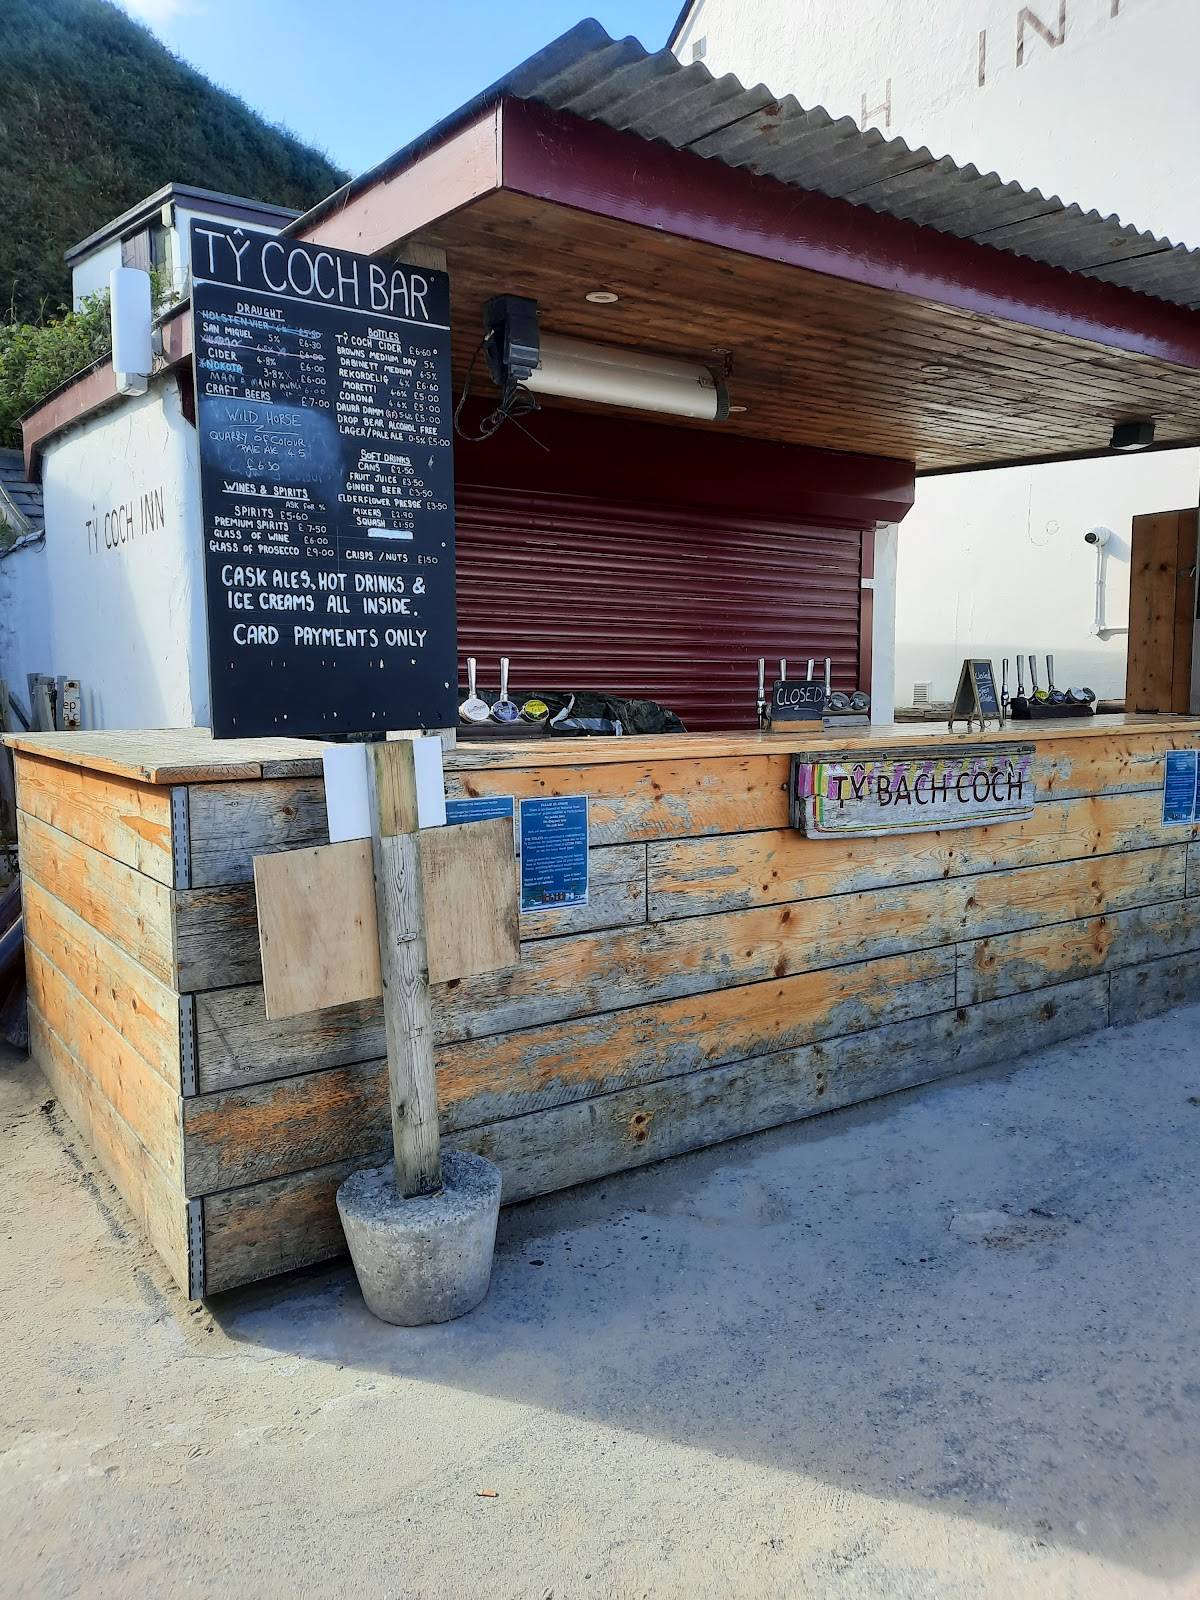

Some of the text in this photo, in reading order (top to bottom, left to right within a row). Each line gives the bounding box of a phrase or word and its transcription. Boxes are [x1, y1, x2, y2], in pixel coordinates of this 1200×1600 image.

[195, 227, 429, 320] TŶ COCH BAR
[236, 302, 283, 318] DRAUGHT
[203, 322, 322, 350] SAN MIGUEL 5% £6.30
[351, 336, 373, 348] COCH
[378, 341, 402, 354] CIDER
[409, 346, 432, 357] £6.60
[208, 347, 325, 373] CIDER 4.8% £6.00
[336, 346, 435, 369] BROWNS MEDIUM DRY 5%
[340, 357, 379, 371] DABINETT
[384, 365, 413, 377] MEDIUM
[264, 368, 285, 380] 3.8%
[301, 374, 327, 385] £6.00
[338, 368, 389, 385] REKORDELIG
[416, 381, 439, 392] £6.60
[205, 382, 239, 396] CRAFT
[245, 388, 272, 401] BEERS
[301, 396, 330, 408] £7.00
[343, 381, 377, 393] MORETTI
[414, 392, 440, 403] £5.00
[339, 391, 374, 404] CORONA
[414, 402, 441, 413] £5.00
[225, 407, 302, 427] WILD HORSE
[336, 402, 360, 413] DAURA
[363, 407, 384, 417] DAMM
[415, 414, 441, 425] £5.00
[337, 414, 438, 436] DROP BEAR ALCOHOL FREE
[209, 431, 248, 443] QUARRY
[390, 432, 404, 441] ALE
[428, 436, 451, 447] £5.00
[358, 462, 414, 475] CANS £2.50
[384, 454, 411, 465] DRINKS
[349, 472, 424, 487] FRUIT JUICE £3.50
[223, 481, 308, 499] WINES & SPIRITS
[346, 482, 433, 497] GINGER BEER £3.50
[285, 501, 300, 510] ASK
[338, 493, 391, 506] ELDERFLOWER
[427, 502, 448, 510] £3.50
[104, 503, 135, 550] COCH
[140, 486, 166, 535] INN
[234, 505, 308, 521] SPIRITS £5.60
[353, 508, 414, 519] MIXERS £2.90
[214, 516, 254, 529] PREMIUM
[257, 520, 289, 532] SPIRITS
[356, 517, 415, 529] SQUASH £1.50
[214, 529, 329, 545] GLASS OF WINE £6.00
[209, 540, 239, 553] GLASS
[258, 544, 300, 556] PROSECCO
[306, 547, 334, 557] £9.00
[345, 550, 374, 560] CRISPS
[221, 565, 267, 587] CASK
[318, 571, 348, 592] HOT
[354, 574, 405, 594] DRINKS
[412, 576, 426, 595] &
[227, 590, 254, 610] ICE
[259, 592, 315, 612] CREAMS
[327, 595, 351, 614] ALL
[233, 623, 428, 648] CARD PAYMENTS ONLY
[777, 687, 824, 706] CLOSED
[877, 772, 952, 807] BACH
[956, 771, 1023, 803] COCH
